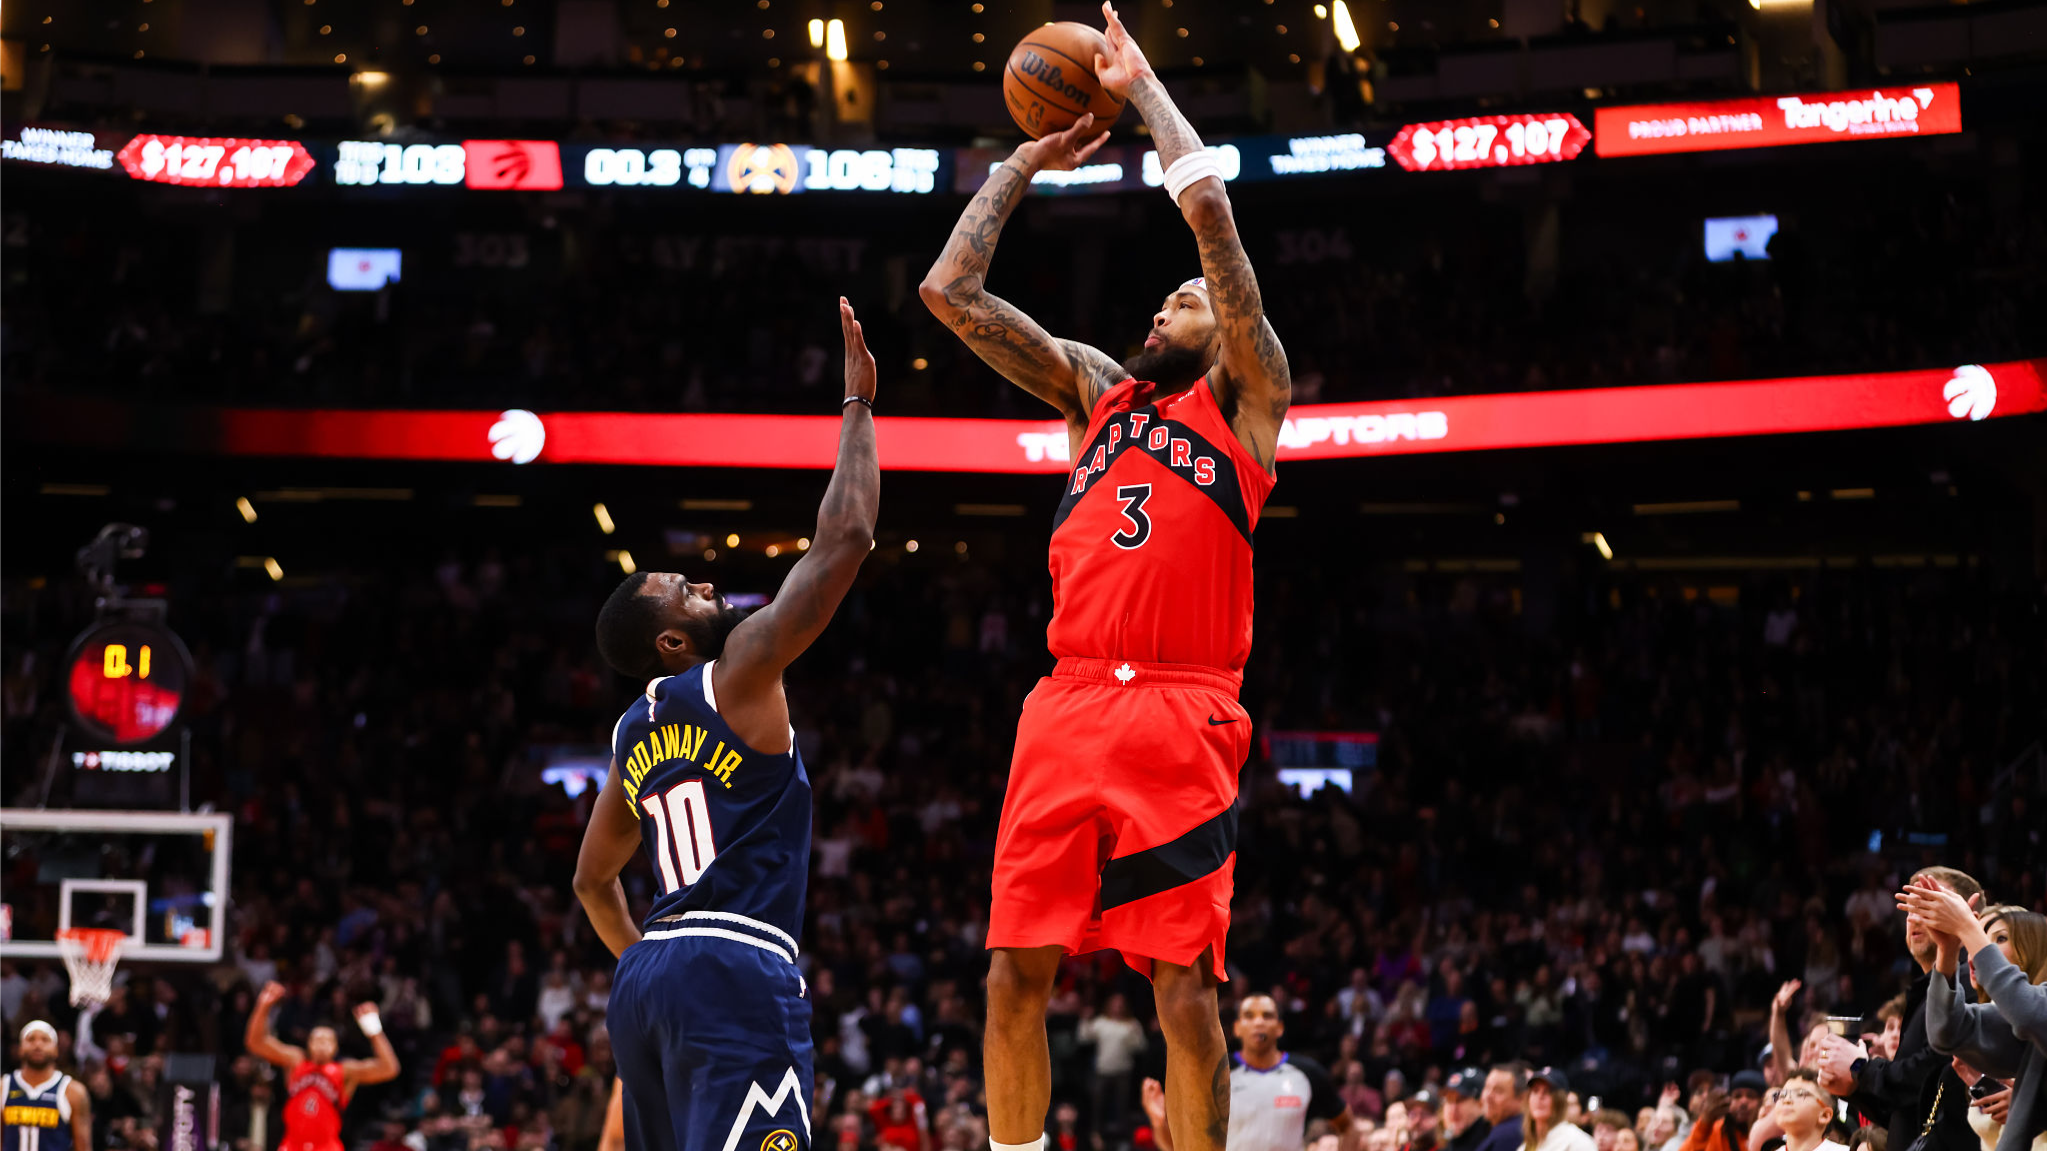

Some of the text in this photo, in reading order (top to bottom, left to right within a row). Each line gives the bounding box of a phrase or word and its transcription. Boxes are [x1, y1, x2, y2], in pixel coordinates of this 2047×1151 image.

[1021, 51, 1092, 108] Wilson
[1629, 113, 1763, 139] PROUD PARTNER
[1777, 91, 1919, 132] Tangerine
[141, 138, 294, 185] $127,107
[1412, 118, 1569, 171] $127,107
[1277, 410, 1449, 448] APTORS
[1070, 413, 1216, 495] RAPTORS
[1110, 483, 1152, 550] 3
[103, 644, 151, 680] 0.1
[703, 740, 743, 789] JR.
[639, 778, 718, 895] 10
